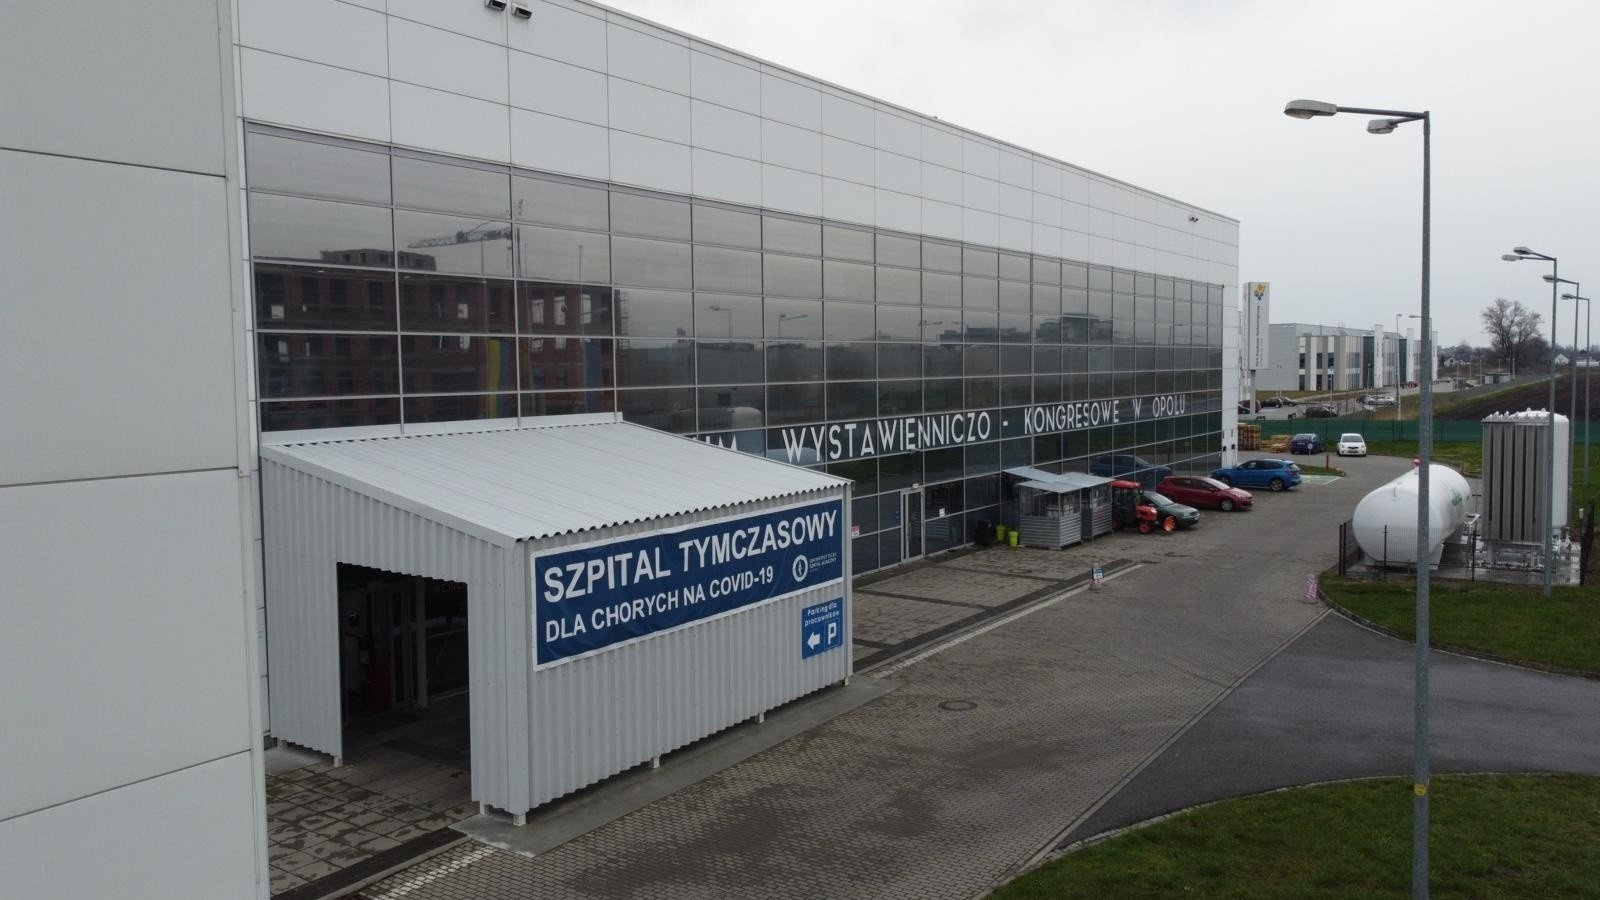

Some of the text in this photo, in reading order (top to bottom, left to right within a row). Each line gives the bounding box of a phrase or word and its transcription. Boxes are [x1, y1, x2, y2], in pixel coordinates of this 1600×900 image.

[782, 411, 991, 464] WYSTAWIENNICZO
[1024, 399, 1120, 435] KONGRESOWE
[1132, 397, 1142, 420] W
[1152, 394, 1186, 418] OPOLU
[543, 509, 838, 603] SZPITAL TYMCZASOWY
[545, 565, 774, 643] DLA CHORYCH NA COVID-19
[807, 605, 828, 617] Parking
[828, 621, 837, 645] P
